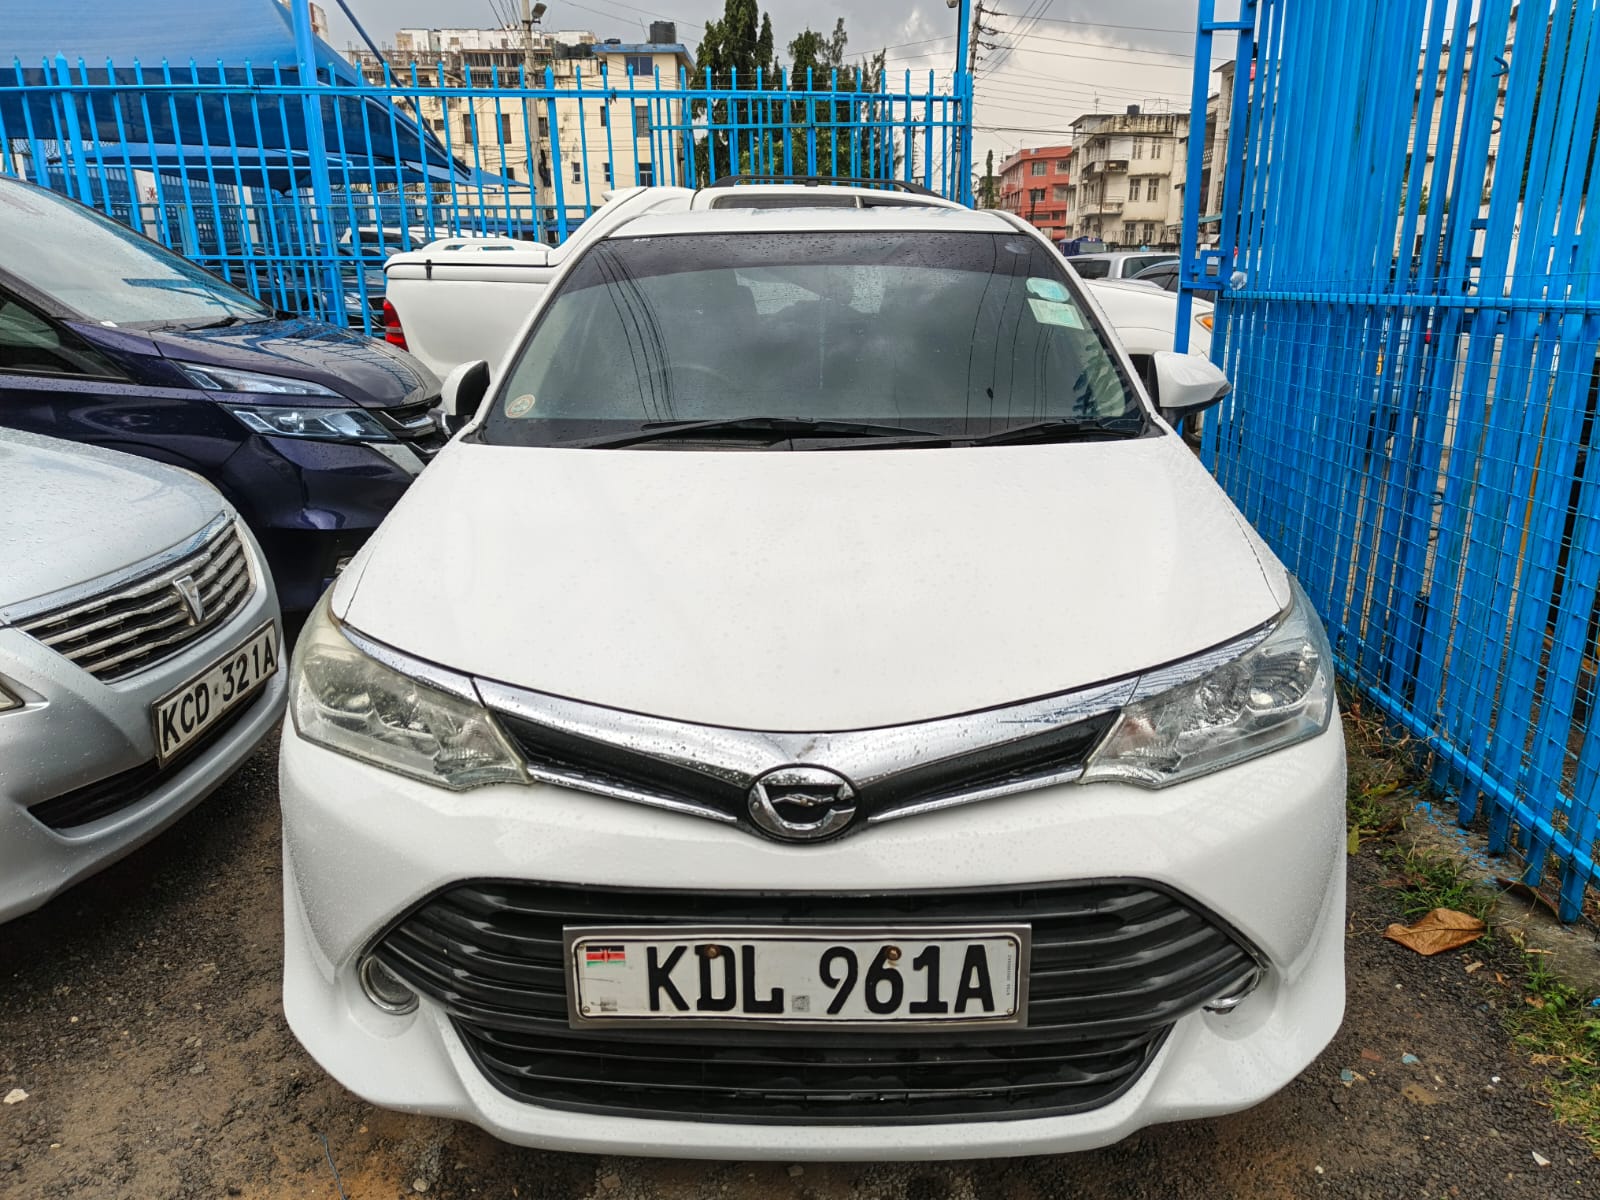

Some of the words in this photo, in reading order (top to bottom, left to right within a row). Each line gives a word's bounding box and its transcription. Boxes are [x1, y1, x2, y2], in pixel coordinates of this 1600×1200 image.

[162, 683, 210, 752] KCD
[222, 636, 275, 702] 321A
[646, 945, 785, 1013] KDL
[819, 945, 995, 1015] 961A
